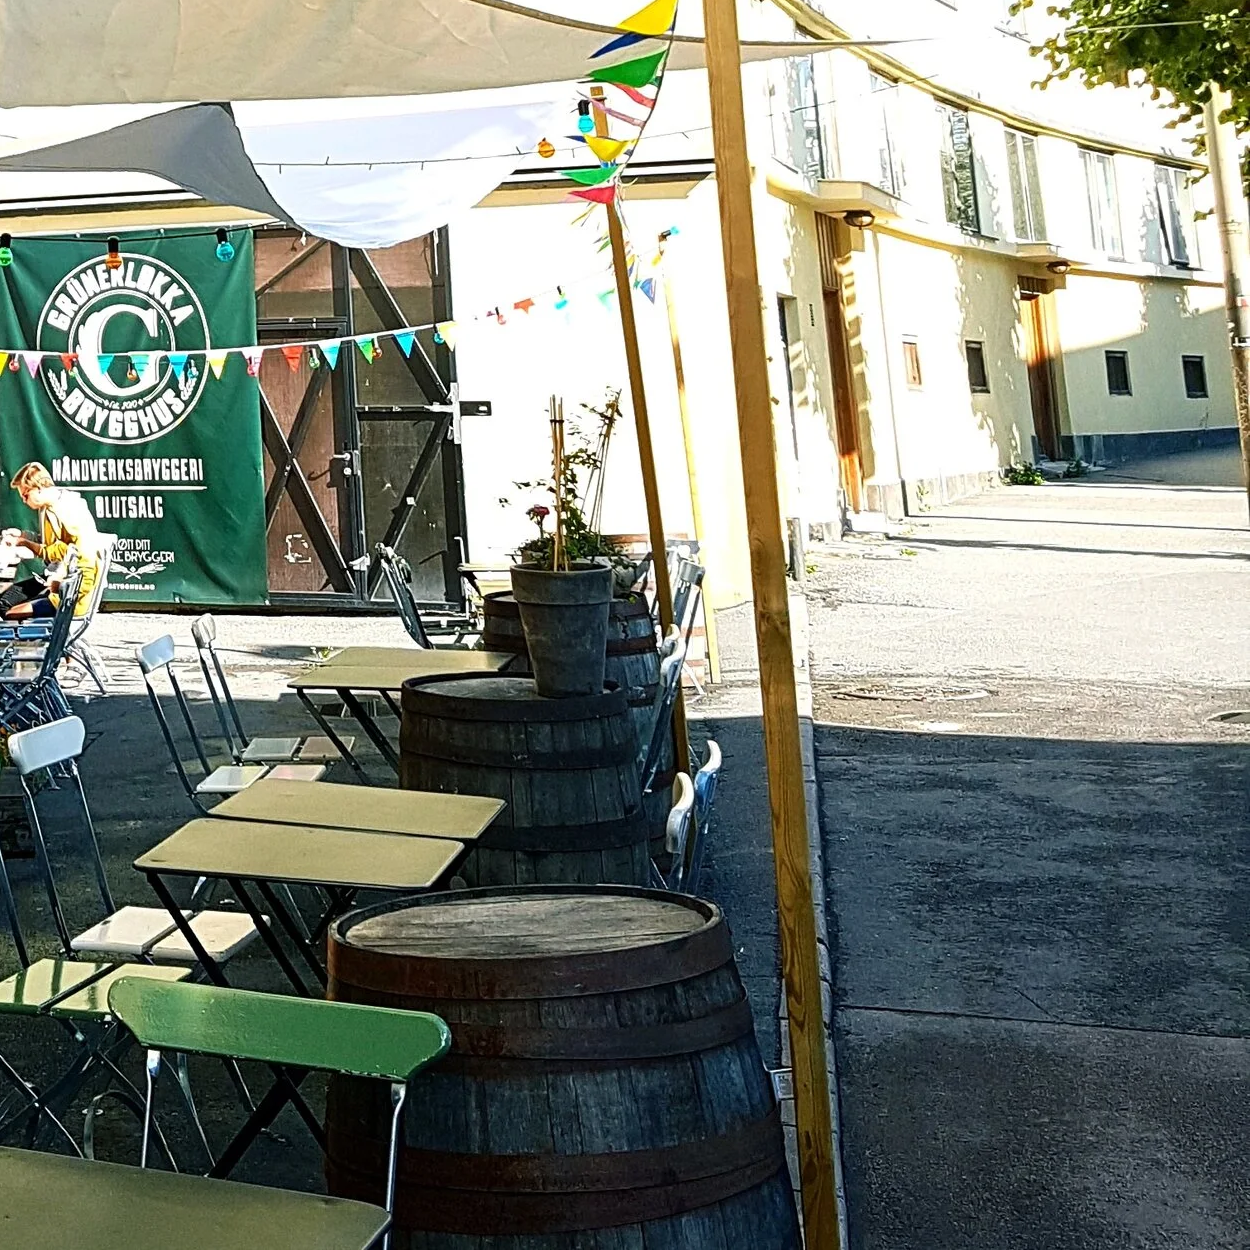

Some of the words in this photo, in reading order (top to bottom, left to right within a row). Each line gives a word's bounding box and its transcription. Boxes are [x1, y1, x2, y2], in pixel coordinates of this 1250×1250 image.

[47, 261, 194, 331] GRÜNERLØKKA
[62, 388, 185, 438] BRYGGHUS
[52, 455, 204, 482] HÅNDVERKSBRYGGERI
[95, 495, 164, 519] ØLUTSALG
[124, 550, 175, 563] BRYGGERI
